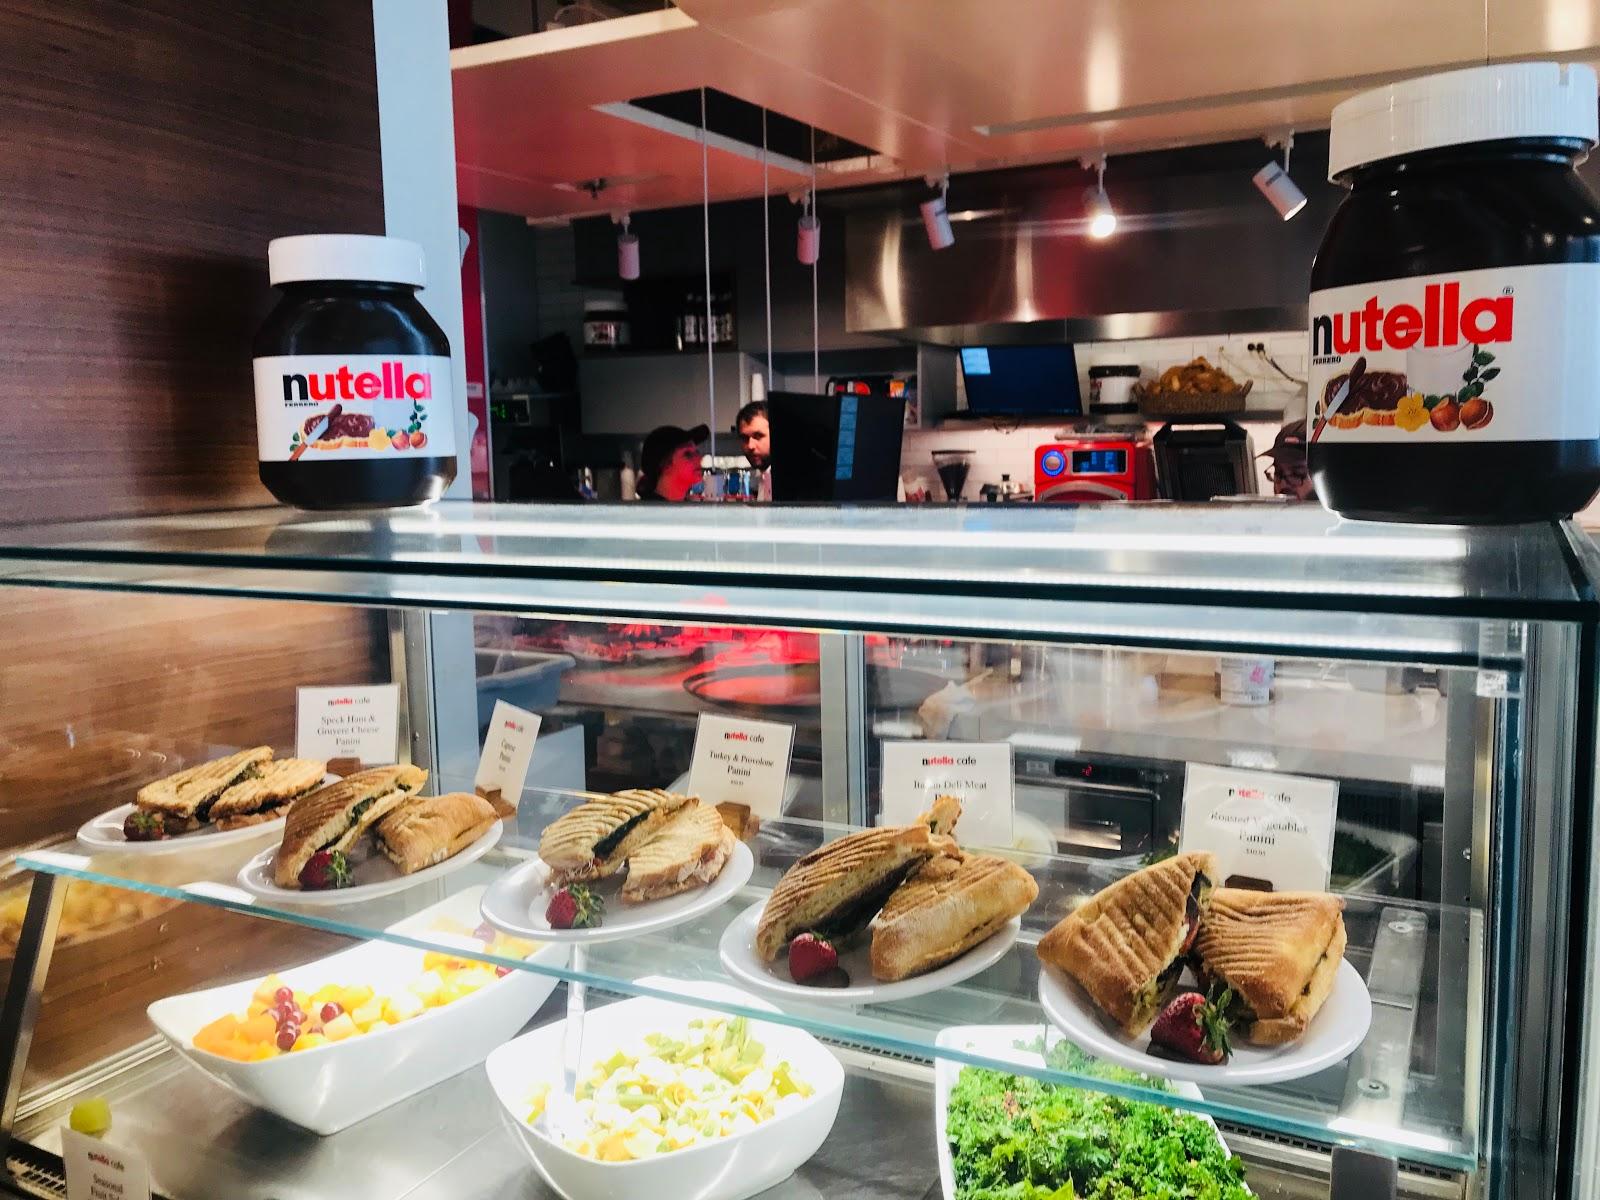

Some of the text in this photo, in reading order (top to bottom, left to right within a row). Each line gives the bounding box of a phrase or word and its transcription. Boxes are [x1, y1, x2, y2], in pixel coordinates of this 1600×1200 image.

[1312, 281, 1515, 355] nutella
[282, 361, 433, 401] nutella
[724, 731, 765, 743] nutella cafe
[709, 751, 731, 763] Turkey
[741, 755, 774, 767] Provolone
[922, 756, 977, 766] nutella cafe
[727, 765, 751, 777] Panini
[913, 780, 987, 790] Itaan Deli Meat
[1228, 787, 1265, 800] ntella
[1210, 811, 1309, 835] Roasted Vgetables
[1239, 831, 1275, 846] Panini
